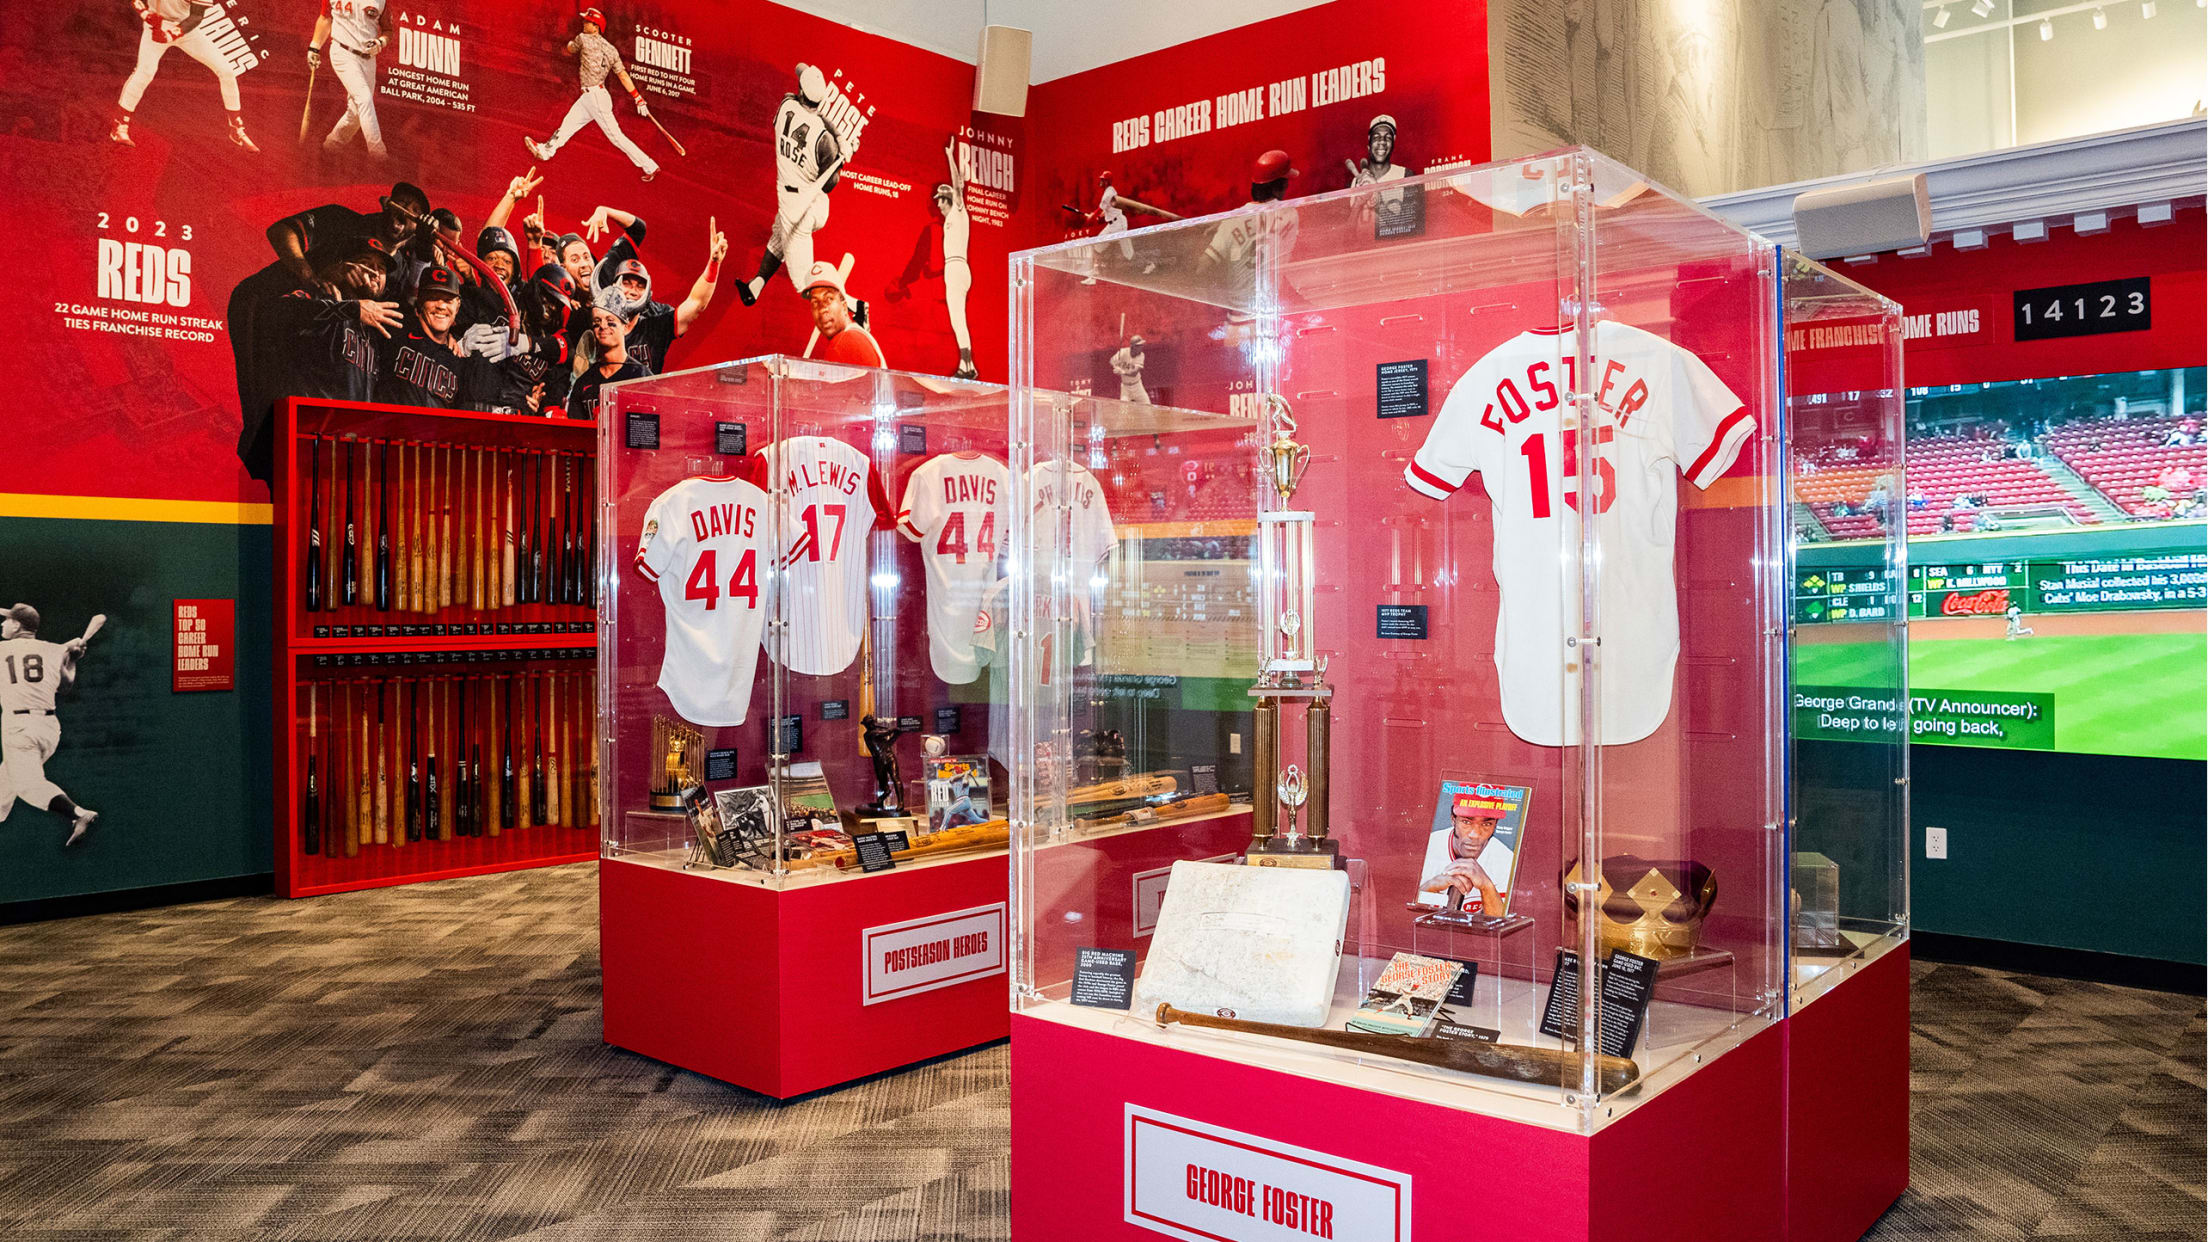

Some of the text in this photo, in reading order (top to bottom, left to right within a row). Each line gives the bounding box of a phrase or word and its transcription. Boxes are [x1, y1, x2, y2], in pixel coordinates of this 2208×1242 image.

[226, 0, 269, 59] ERIC
[400, 11, 460, 35] ADAM
[635, 24, 692, 46] SCOOTER
[199, 3, 259, 78] DAVIS
[399, 27, 460, 77] DUNN
[635, 35, 692, 75] GENNETT
[388, 67, 469, 91] LONGEST HOME RUN
[629, 72, 648, 83] HOME
[648, 77, 665, 87] RUNS
[630, 64, 696, 86] FIRST RED TO HIT FOUR
[380, 86, 476, 113] BALL PARK, 2004 535 FT
[388, 78, 469, 101] AT GREAT AMERICAN
[646, 84, 662, 94] JUNE
[834, 69, 876, 118] PETE
[817, 81, 869, 152] ROSE
[1113, 57, 1386, 154] REDS CAREER HOME RUN LEADERS
[783, 110, 810, 151] 14
[959, 125, 1014, 149] JOHNNY
[780, 137, 807, 169] ROSE
[959, 141, 1014, 193] BENCH
[840, 169, 912, 192] MOST CAREER LEAD-OFF
[853, 182, 873, 193] HOME
[968, 186, 984, 196] FINAL
[97, 212, 193, 241] 2023
[97, 238, 192, 308] REDS
[54, 302, 223, 331] 22 GAME HOME RUN STREAK
[64, 317, 214, 343] TIES FRANCHISE RECORD
[1809, 309, 1980, 350] FRANCHISE RUNS
[1480, 355, 1649, 436] FOSTER
[802, 460, 861, 495] LEWIS
[1521, 424, 1616, 519] 15
[944, 474, 997, 505] DAVIS
[690, 503, 756, 542] DAVIS
[801, 504, 847, 562] 17
[937, 512, 995, 564] 44
[685, 549, 758, 610] 44
[1928, 566, 1947, 577] SEA
[2101, 575, 2150, 588] collected
[1831, 584, 1846, 594] WP
[1928, 579, 1945, 589] WP
[2178, 590, 2186, 599] a
[178, 606, 197, 618] REDS
[1831, 609, 1847, 619] WP
[1832, 597, 1849, 607] CLE
[178, 619, 206, 631] TOP 50
[178, 632, 206, 645] CAREER
[178, 645, 219, 657] HOME RUN
[5, 654, 44, 684] 18
[178, 658, 208, 671] LEADERS
[1794, 694, 2038, 719] George (TV Announcer):
[1821, 714, 2004, 737] Deep to going back,
[1442, 782, 1524, 799] Sports Illustrated
[885, 931, 988, 974] POSTSEASON HEROES
[1381, 961, 1451, 984] GEORGE FOSTER
[1393, 961, 1408, 972] THE
[1422, 973, 1451, 985] STORY
[1186, 1163, 1333, 1240] GEORGE FOSTER
